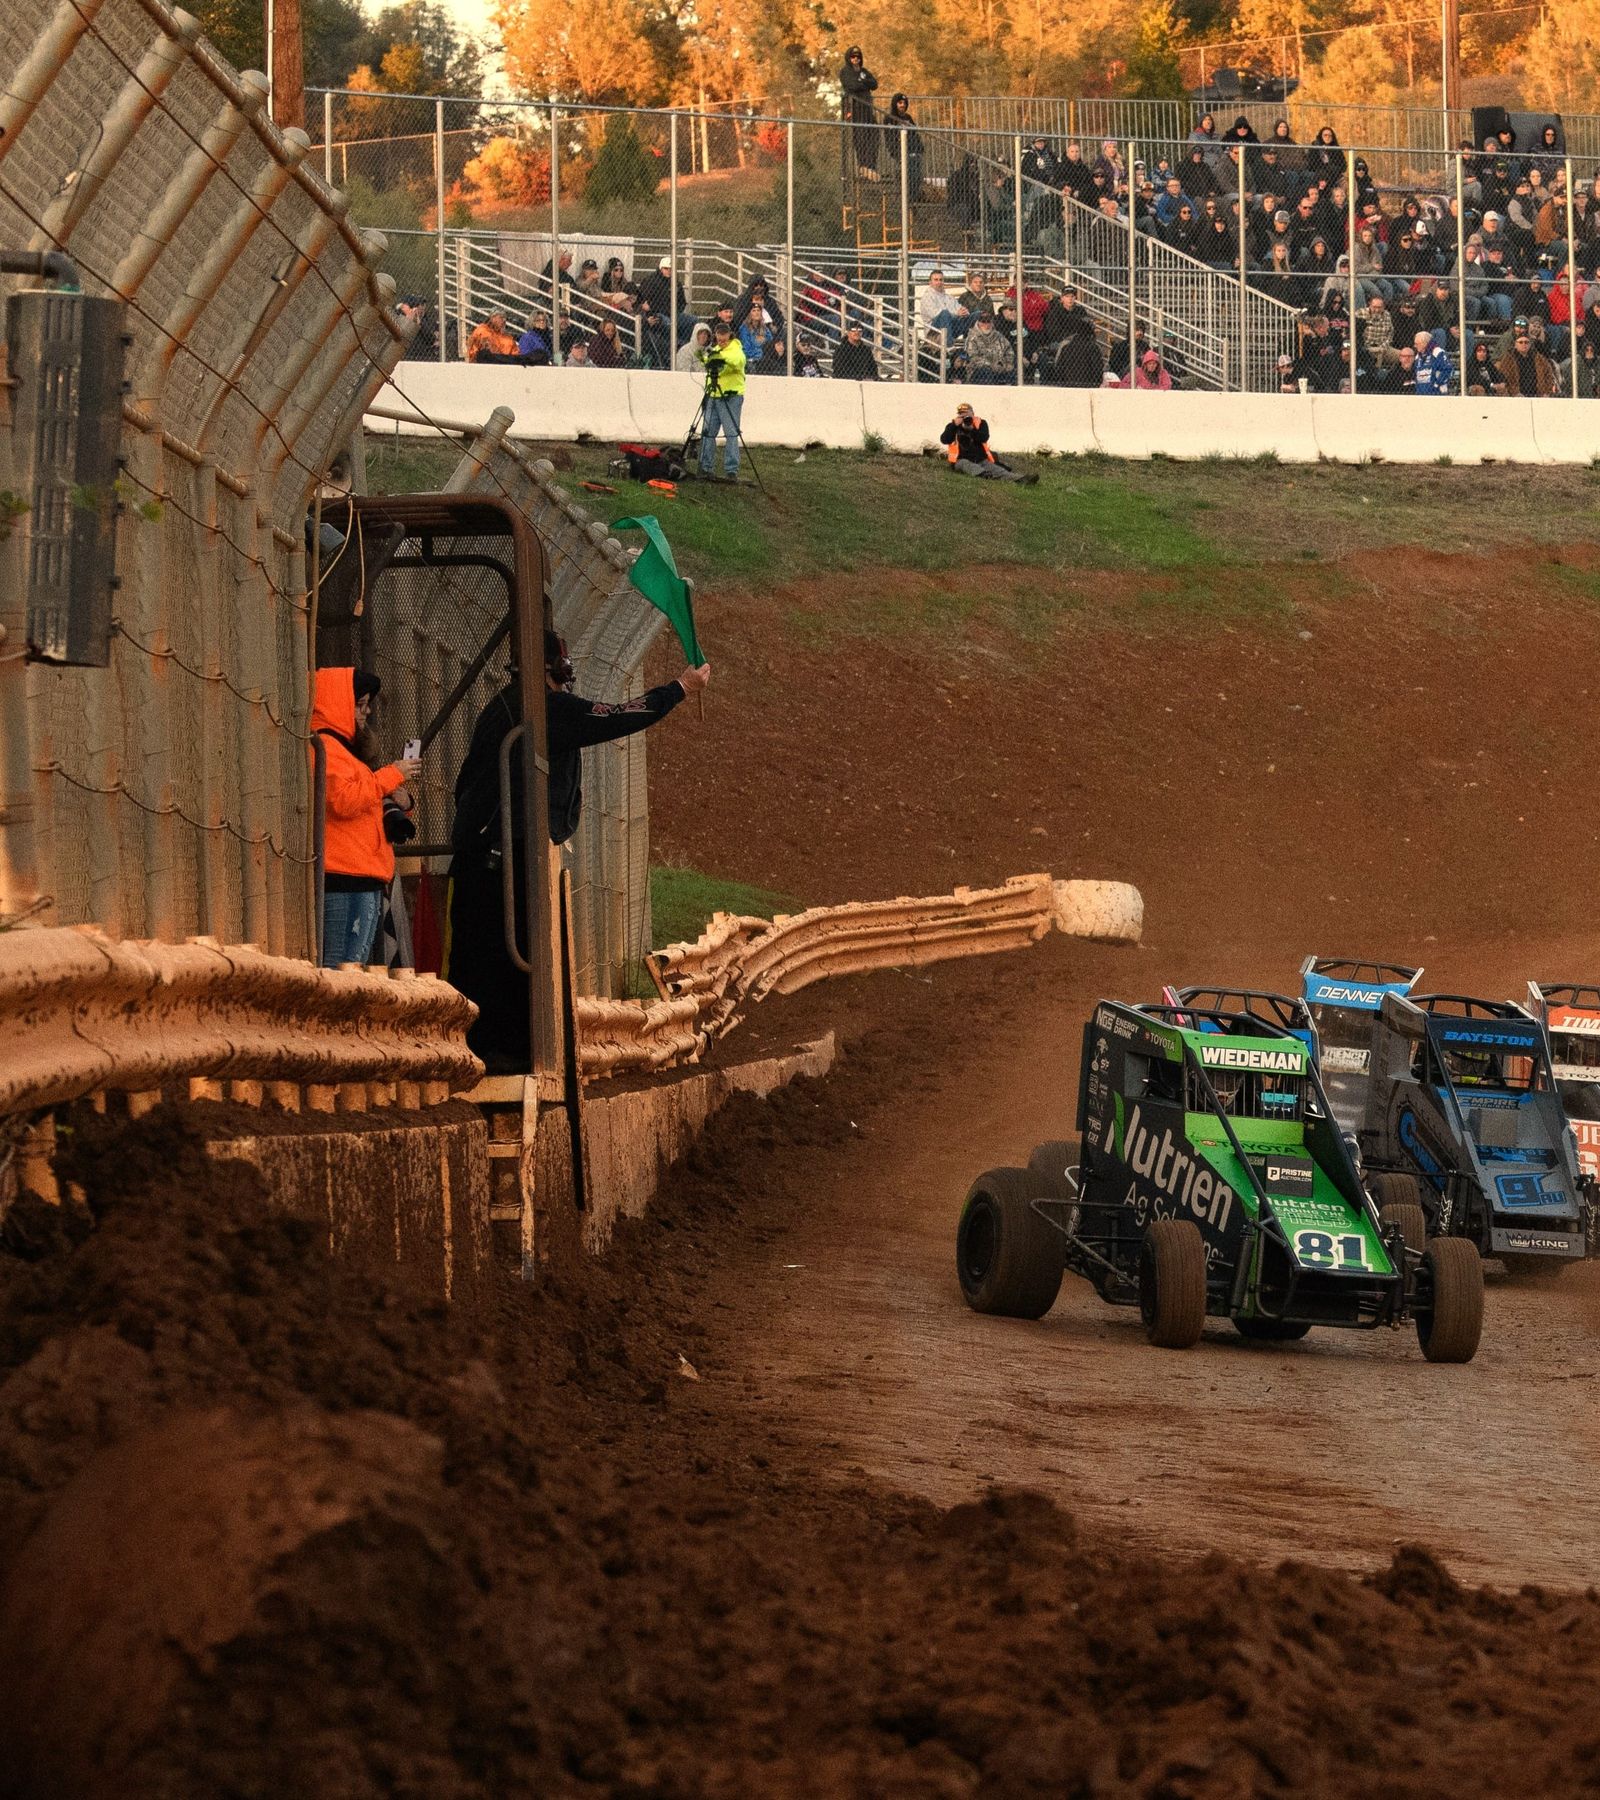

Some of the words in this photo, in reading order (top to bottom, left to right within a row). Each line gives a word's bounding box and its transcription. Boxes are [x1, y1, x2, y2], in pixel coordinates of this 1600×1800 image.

[1316, 986, 1385, 1004] DENNE
[1113, 1025, 1132, 1040] DRINK
[1115, 1017, 1139, 1033] ENERGY
[1149, 1032, 1175, 1051] TOYOTA
[1443, 1031, 1535, 1047] BAYSTON
[1202, 1047, 1302, 1071] WIEDEMAN
[1104, 1104, 1233, 1233] Nutrien
[1281, 1168, 1313, 1178] PRISTINE
[1124, 1181, 1148, 1227] Ag
[1275, 1206, 1319, 1215] EADING
[1294, 1229, 1374, 1272] 81
[1531, 1239, 1569, 1248] KING
